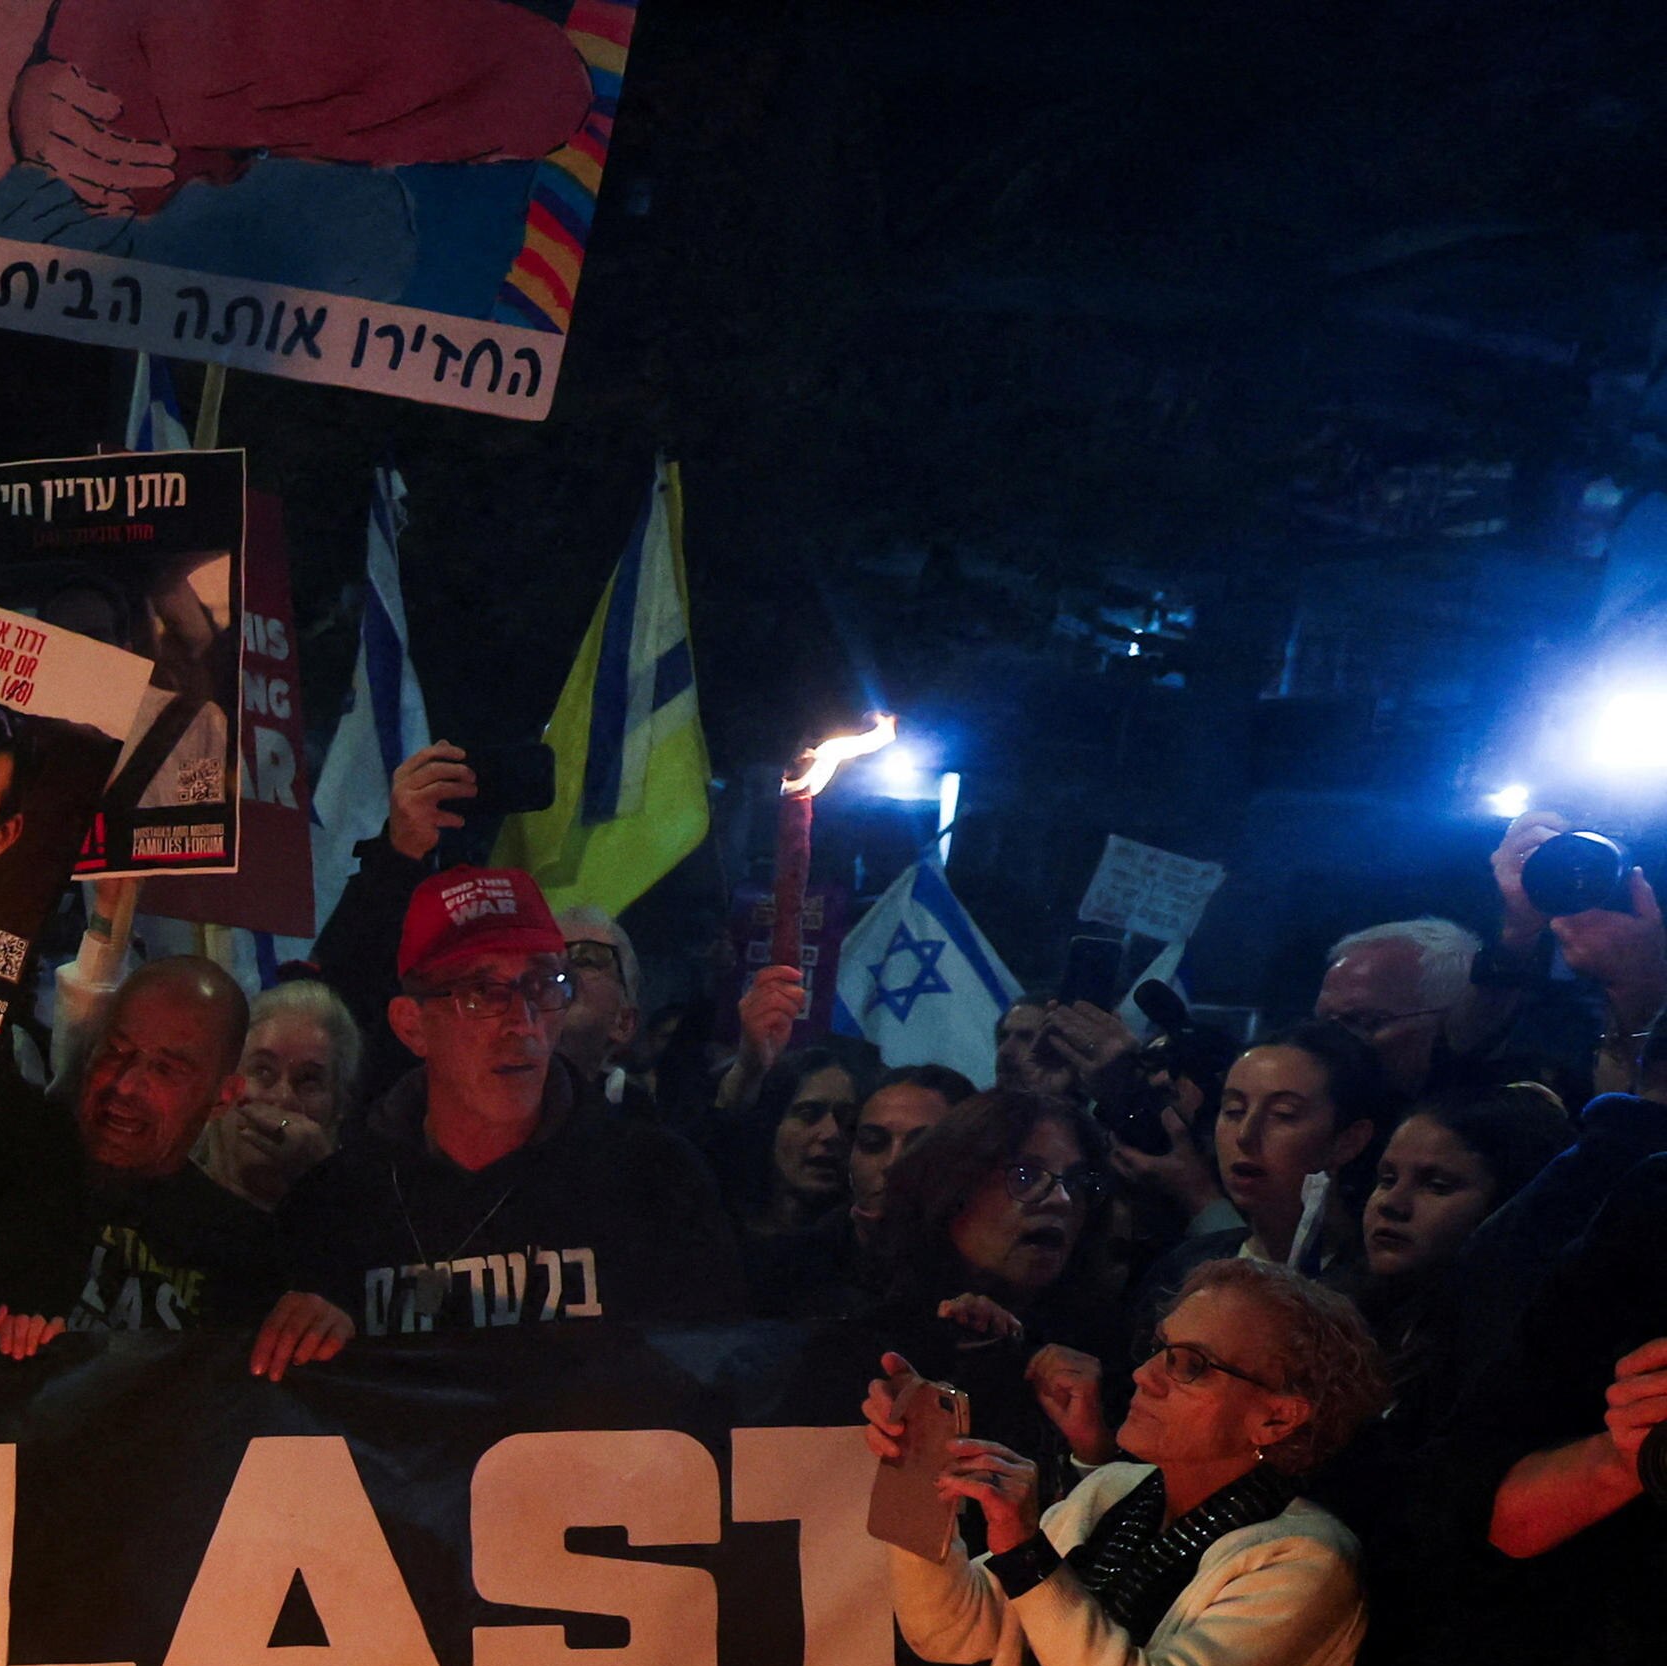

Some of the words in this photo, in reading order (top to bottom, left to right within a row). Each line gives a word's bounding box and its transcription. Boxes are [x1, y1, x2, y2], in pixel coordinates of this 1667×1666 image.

[173, 285, 329, 362] אותה
[351, 317, 543, 398] החזירו
[40, 475, 117, 523] עדיין
[124, 471, 187, 518] מתן
[14, 625, 49, 656] דרור
[13, 654, 39, 680] OR
[132, 836, 183, 857] FAMILIES
[184, 835, 226, 855] FORUM
[440, 880, 475, 900] END
[448, 898, 519, 926] WAR
